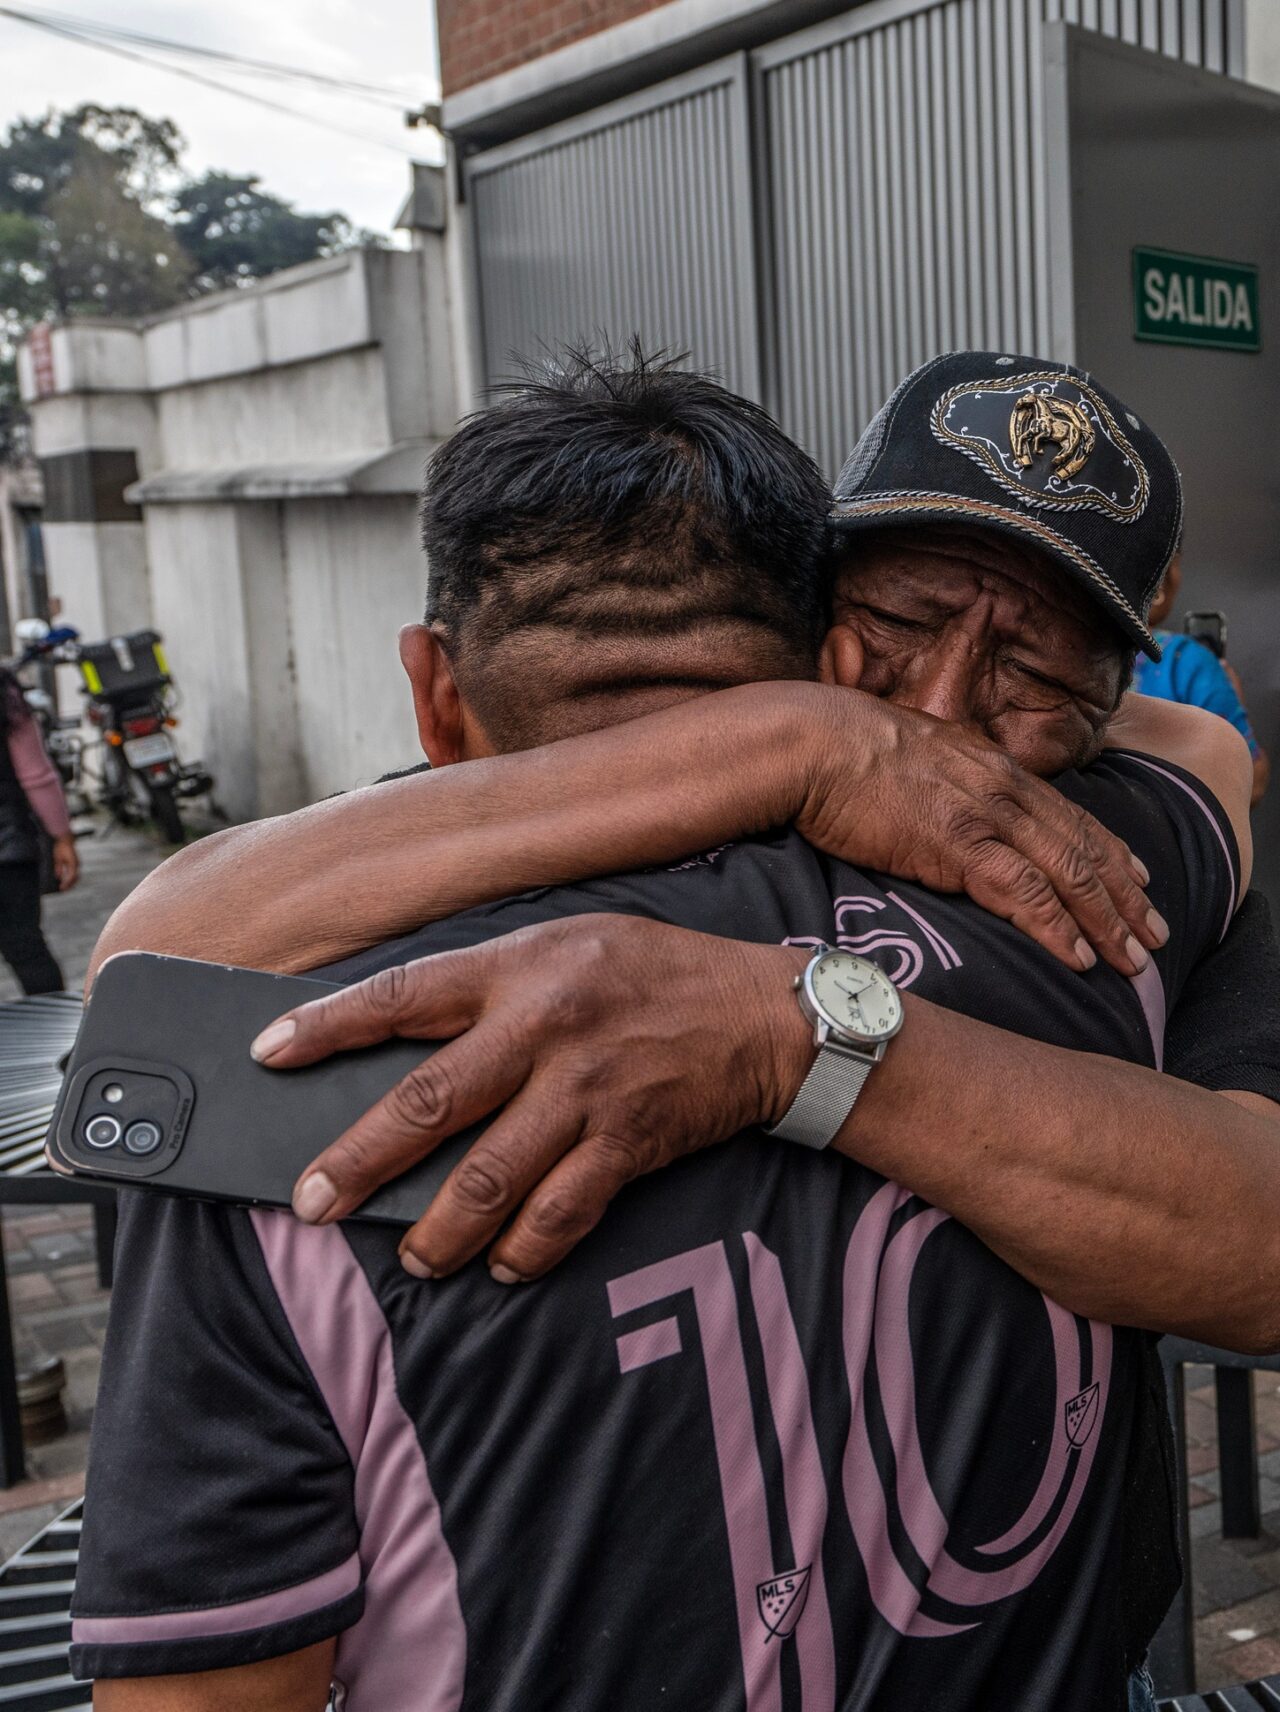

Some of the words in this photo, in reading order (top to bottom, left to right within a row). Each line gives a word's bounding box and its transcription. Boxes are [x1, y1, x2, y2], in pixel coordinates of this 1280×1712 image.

[1144, 268, 1253, 332] SALIDA
[888, 1006, 895, 1016] 9
[878, 1017, 889, 1029] 10
[169, 1134, 180, 1149] Pro
[1068, 1396, 1087, 1416] MLS
[606, 1180, 1114, 1712] 10
[762, 1579, 795, 1600] MLS
